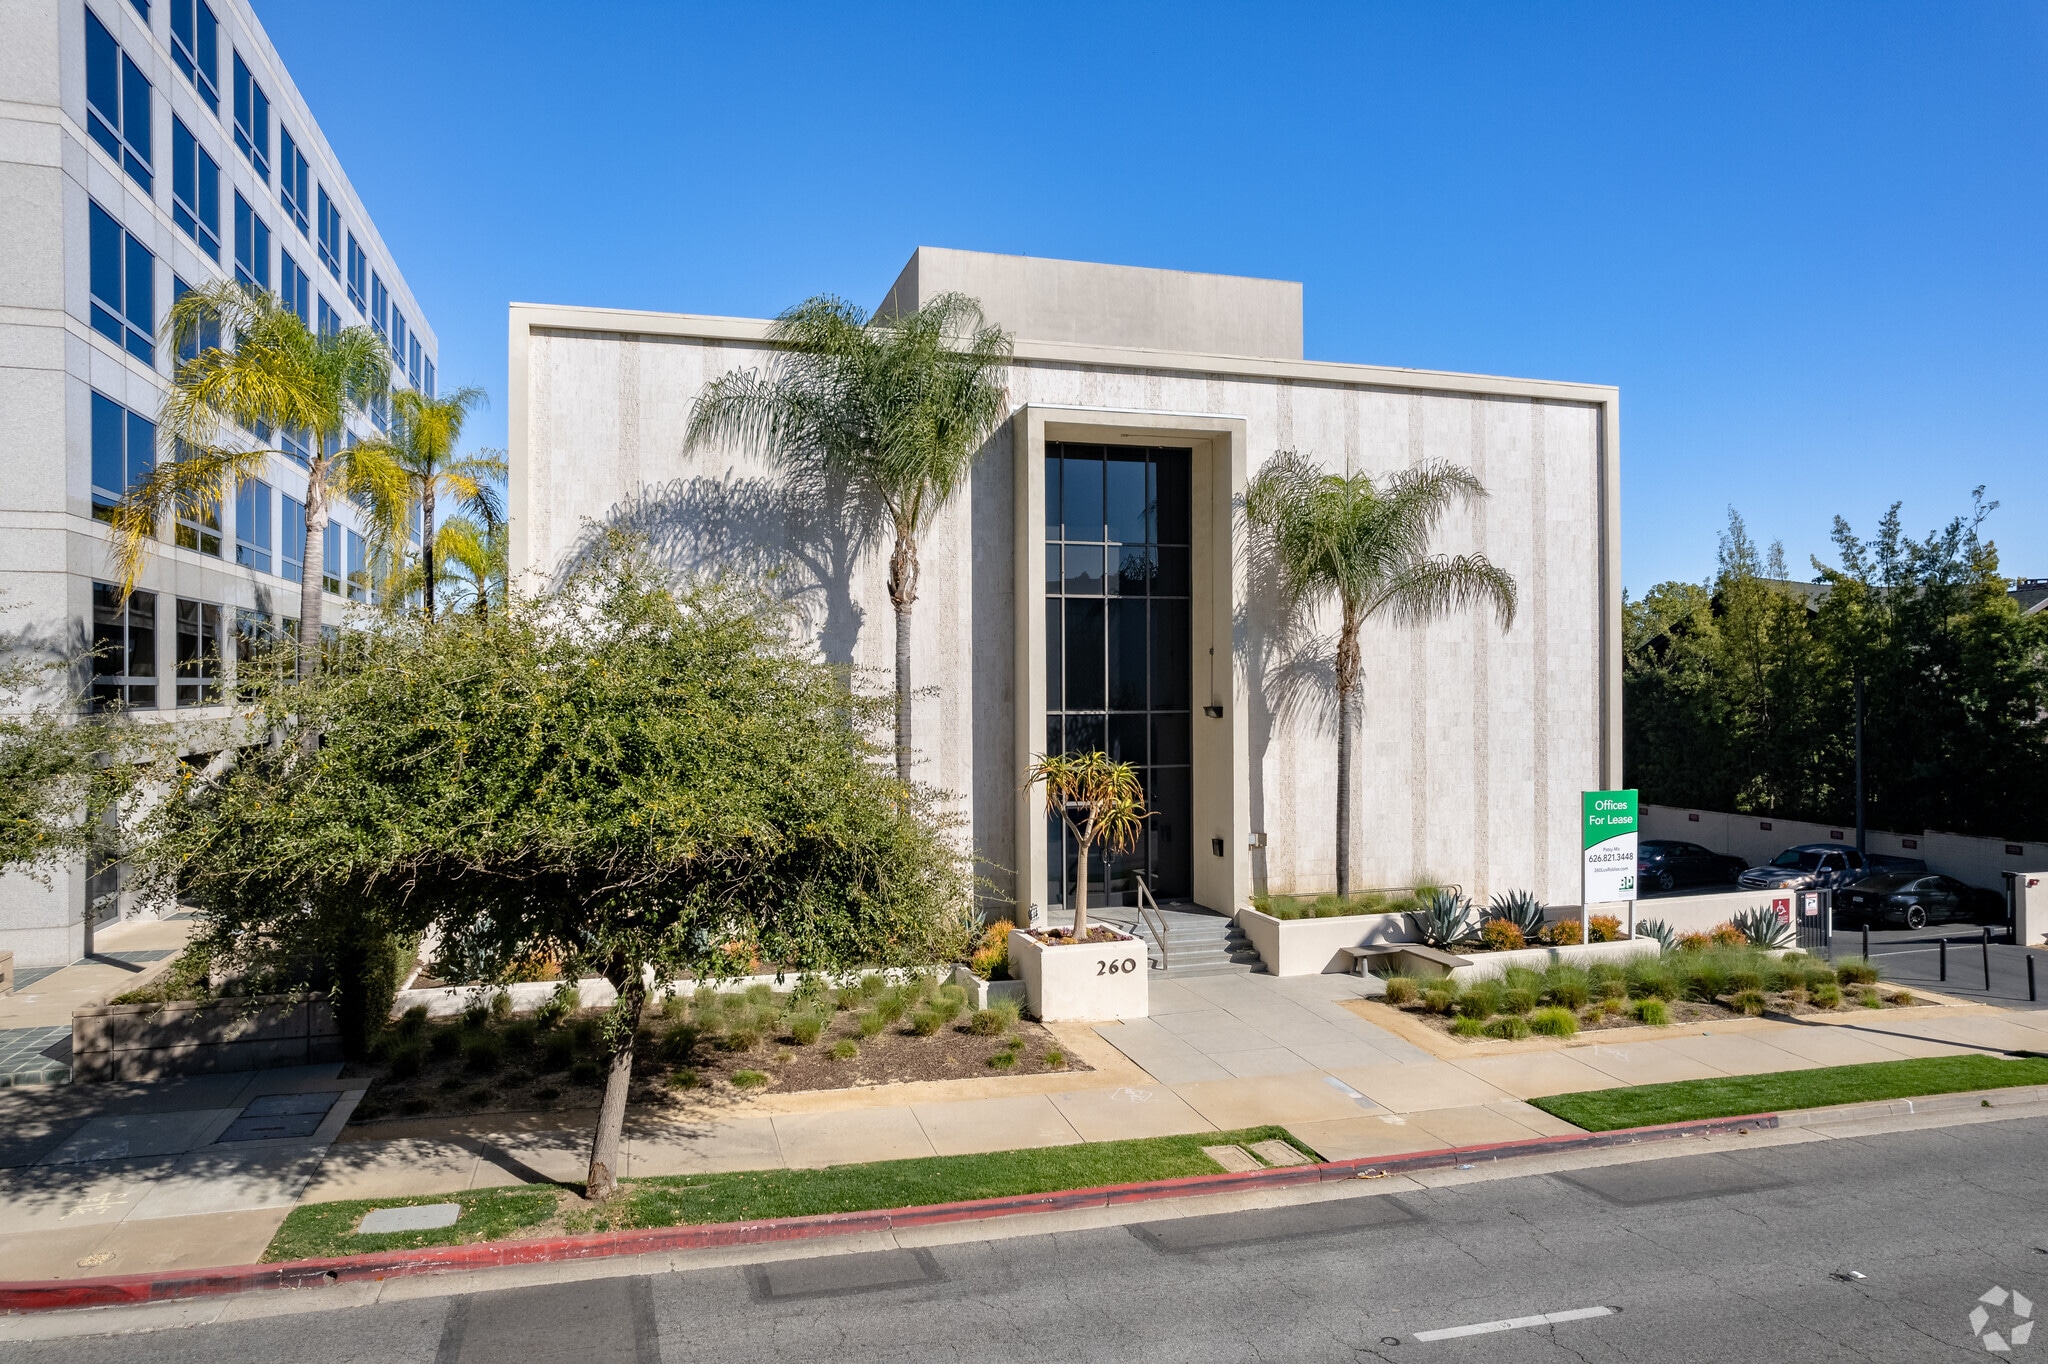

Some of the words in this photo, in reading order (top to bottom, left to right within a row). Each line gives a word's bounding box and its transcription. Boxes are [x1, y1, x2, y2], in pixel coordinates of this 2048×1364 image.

[1595, 800, 1627, 810] Offices
[1589, 815, 1605, 825] For
[1607, 815, 1633, 825] Lease
[1589, 853, 1633, 862] 626.821.3448
[1096, 957, 1137, 976] 260
